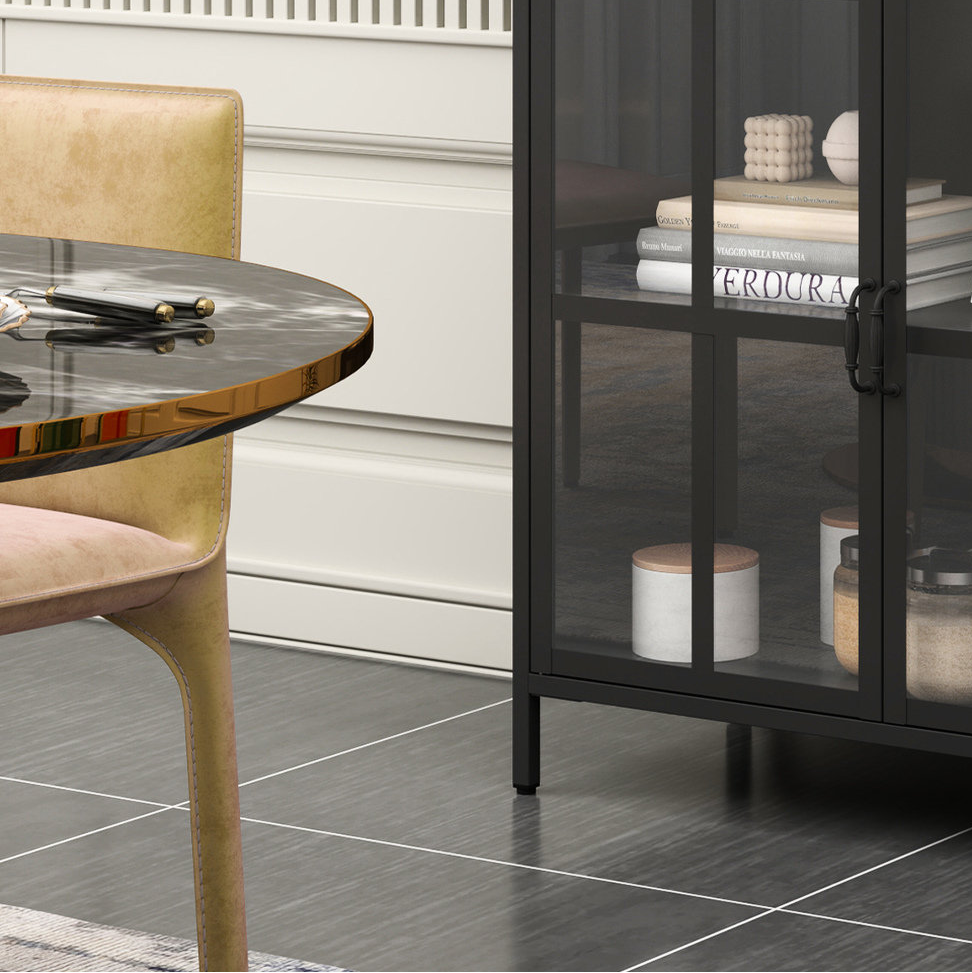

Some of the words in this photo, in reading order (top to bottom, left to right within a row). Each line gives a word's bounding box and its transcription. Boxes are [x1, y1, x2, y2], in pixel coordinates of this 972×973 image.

[716, 246, 747, 257] VIAGGIO
[747, 248, 771, 259] NELLA
[771, 250, 806, 262] FANTASIA
